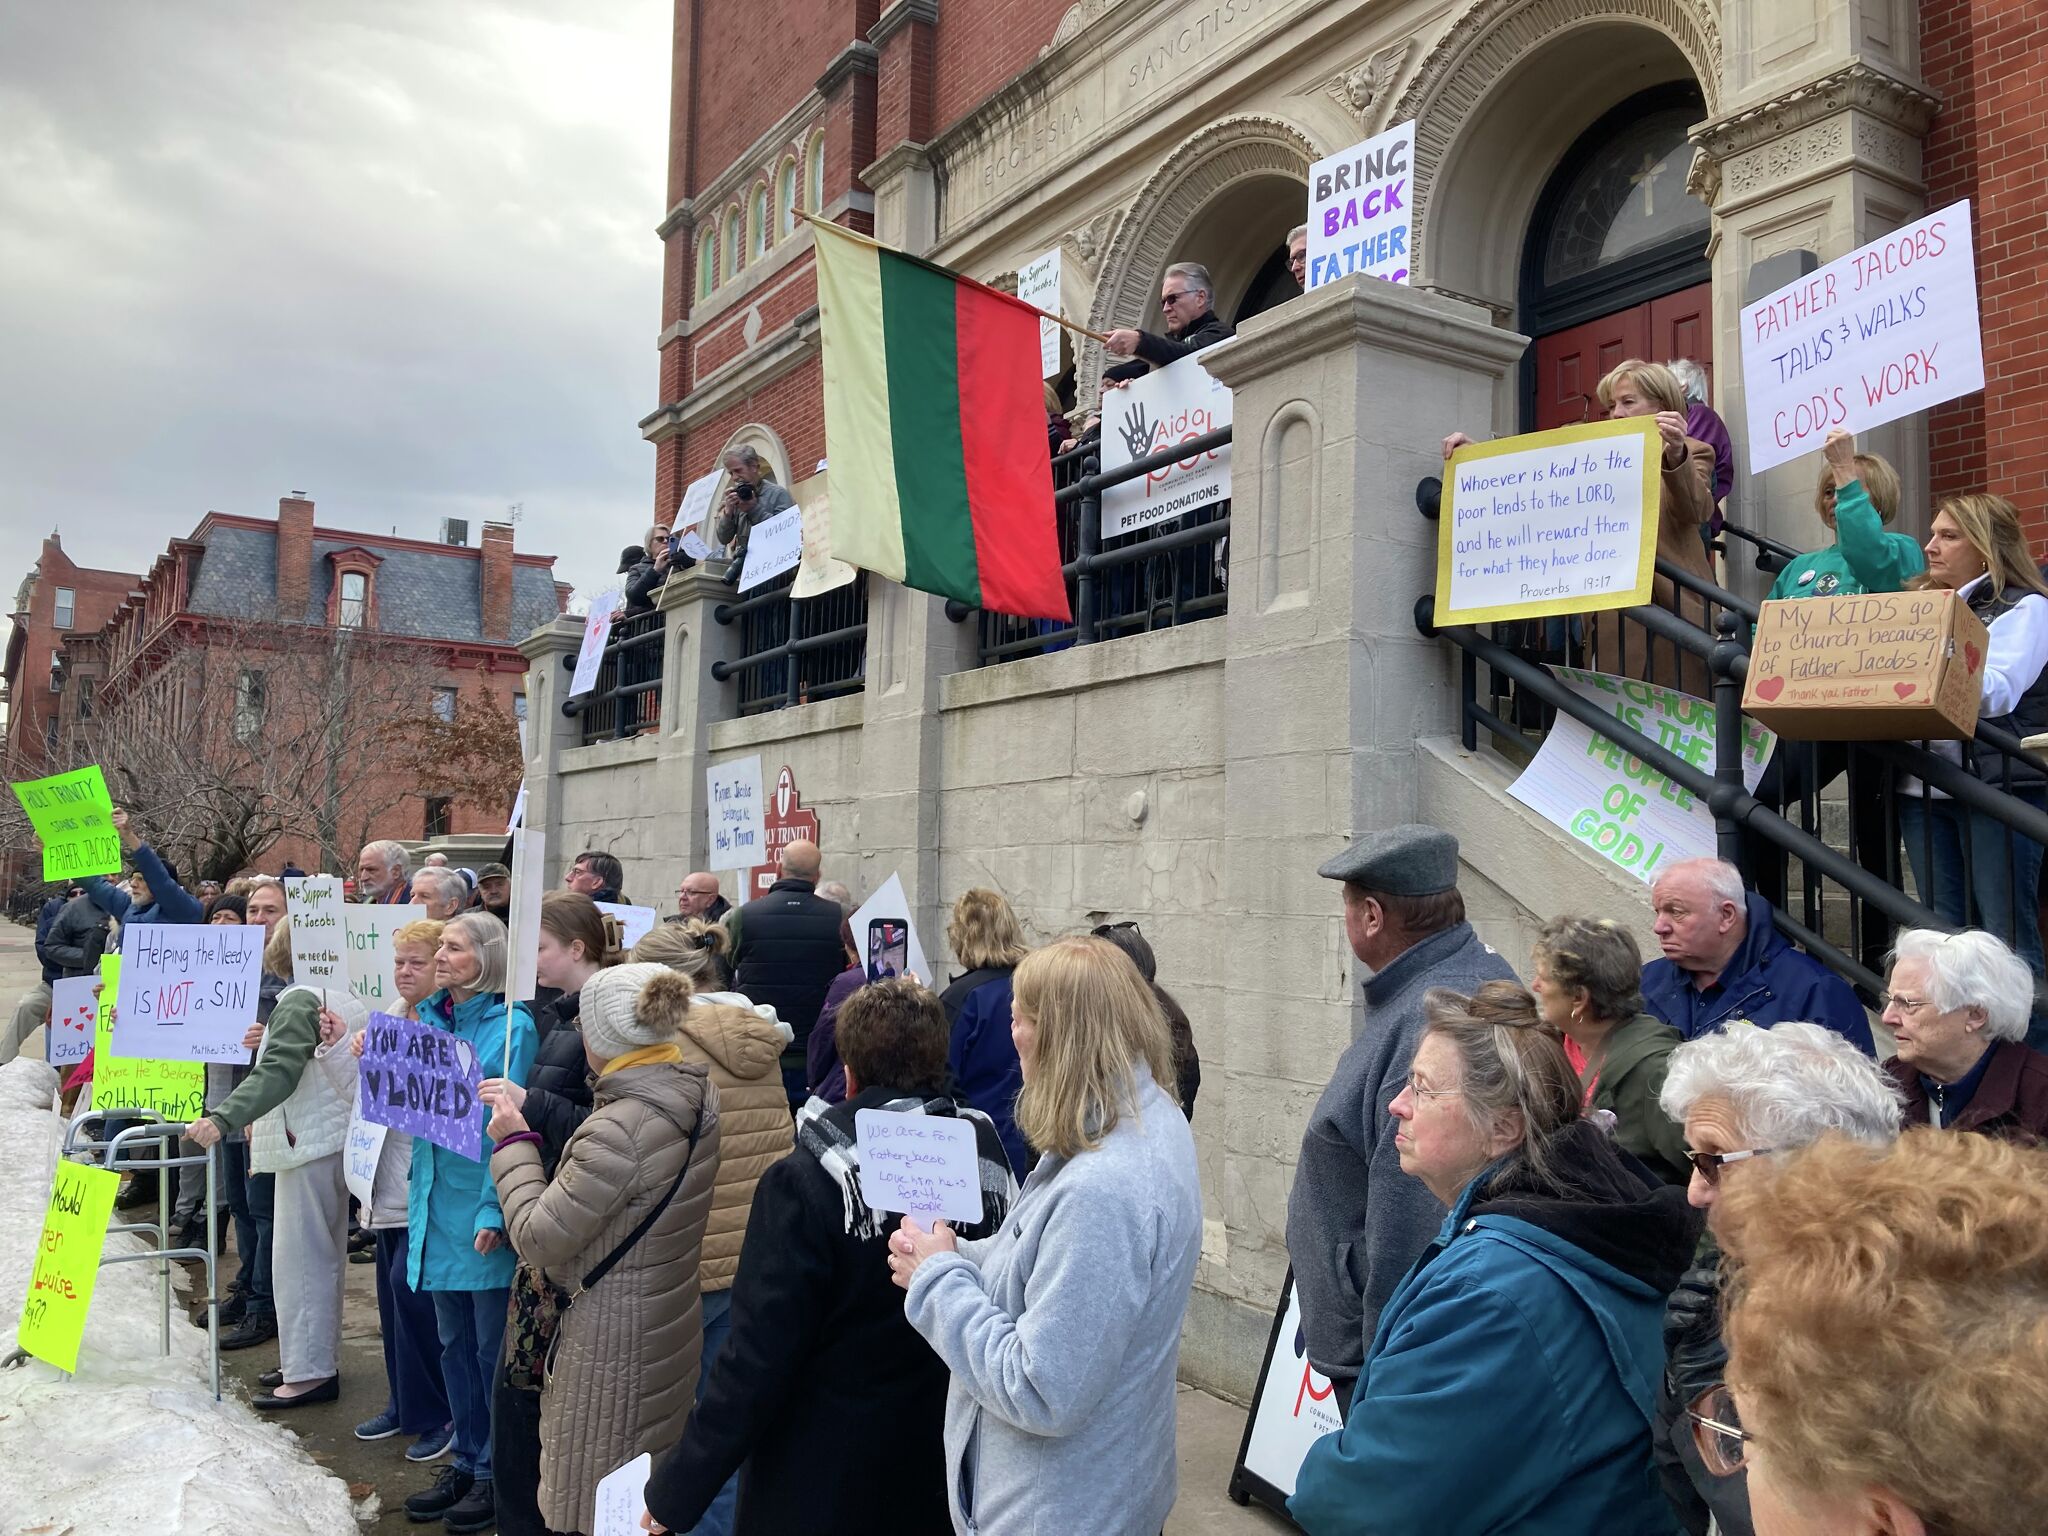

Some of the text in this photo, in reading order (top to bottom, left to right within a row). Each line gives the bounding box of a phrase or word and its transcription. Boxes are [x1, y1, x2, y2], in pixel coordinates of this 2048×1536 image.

[984, 105, 1083, 187] ECCLESIA
[1316, 140, 1408, 202] BRING
[1324, 179, 1406, 237] BACK
[1311, 226, 1407, 288] FATHER
[1754, 222, 1946, 344] FATHER JACOBS
[1771, 329, 1833, 384] TALKS
[1855, 286, 1926, 341] WALKS
[1774, 342, 1939, 448] GOD'S WORK
[1155, 409, 1188, 443] Aid
[1461, 470, 1527, 493] Whoever
[1532, 469, 1544, 482] is
[1581, 453, 1598, 474] to
[1604, 450, 1633, 470] the
[1120, 484, 1220, 528] PET FOOD DONATIONS
[1458, 483, 1616, 527] poor lends to the LORD,
[1456, 515, 1630, 554] and he will reward them
[743, 566, 760, 581] Ask
[774, 545, 801, 568] Jacob
[1456, 562, 1479, 578] for
[1483, 558, 1513, 574] what
[1519, 555, 1548, 577] they
[1552, 551, 1580, 567] have
[1520, 575, 1611, 599] Proverbs 19:17
[1780, 598, 1934, 633] My KIDS go
[1763, 636, 1781, 654] to
[1868, 627, 1939, 644] because
[1790, 656, 1845, 678] Father
[1788, 684, 1878, 700] Thank you Father!
[1615, 702, 1713, 773] IS THE
[1621, 680, 1770, 765] CHURH
[48, 778, 95, 805] TRINITY
[1603, 783, 1648, 822] OF
[778, 825, 811, 843] TRINITY
[1570, 807, 1664, 878] GOD!
[49, 835, 120, 872] FATHER JACOBS
[302, 880, 332, 909] Support
[304, 912, 336, 928] Jacobs
[345, 916, 379, 951] hat
[136, 930, 253, 974] Helping the Needy
[157, 981, 194, 1020] NOT
[194, 998, 204, 1010] a
[210, 980, 247, 1009] SIN
[354, 974, 382, 998] uld
[56, 1040, 93, 1057] Fath
[191, 1045, 219, 1055] Matthew
[371, 1026, 452, 1069] YOU ARE
[97, 1065, 129, 1085] Where
[136, 1060, 150, 1078] He
[160, 1062, 204, 1088] Belongs
[144, 1087, 188, 1121] Trinity
[387, 1070, 472, 1119] LOVED
[350, 1126, 375, 1150] Father
[867, 1124, 891, 1141] We
[896, 1126, 926, 1138] are
[868, 1148, 905, 1160] Father
[39, 1225, 64, 1254] ter
[34, 1255, 77, 1299] Louise
[1309, 1406, 1343, 1428] COMMUNITY
[1318, 1423, 1329, 1434] PET
